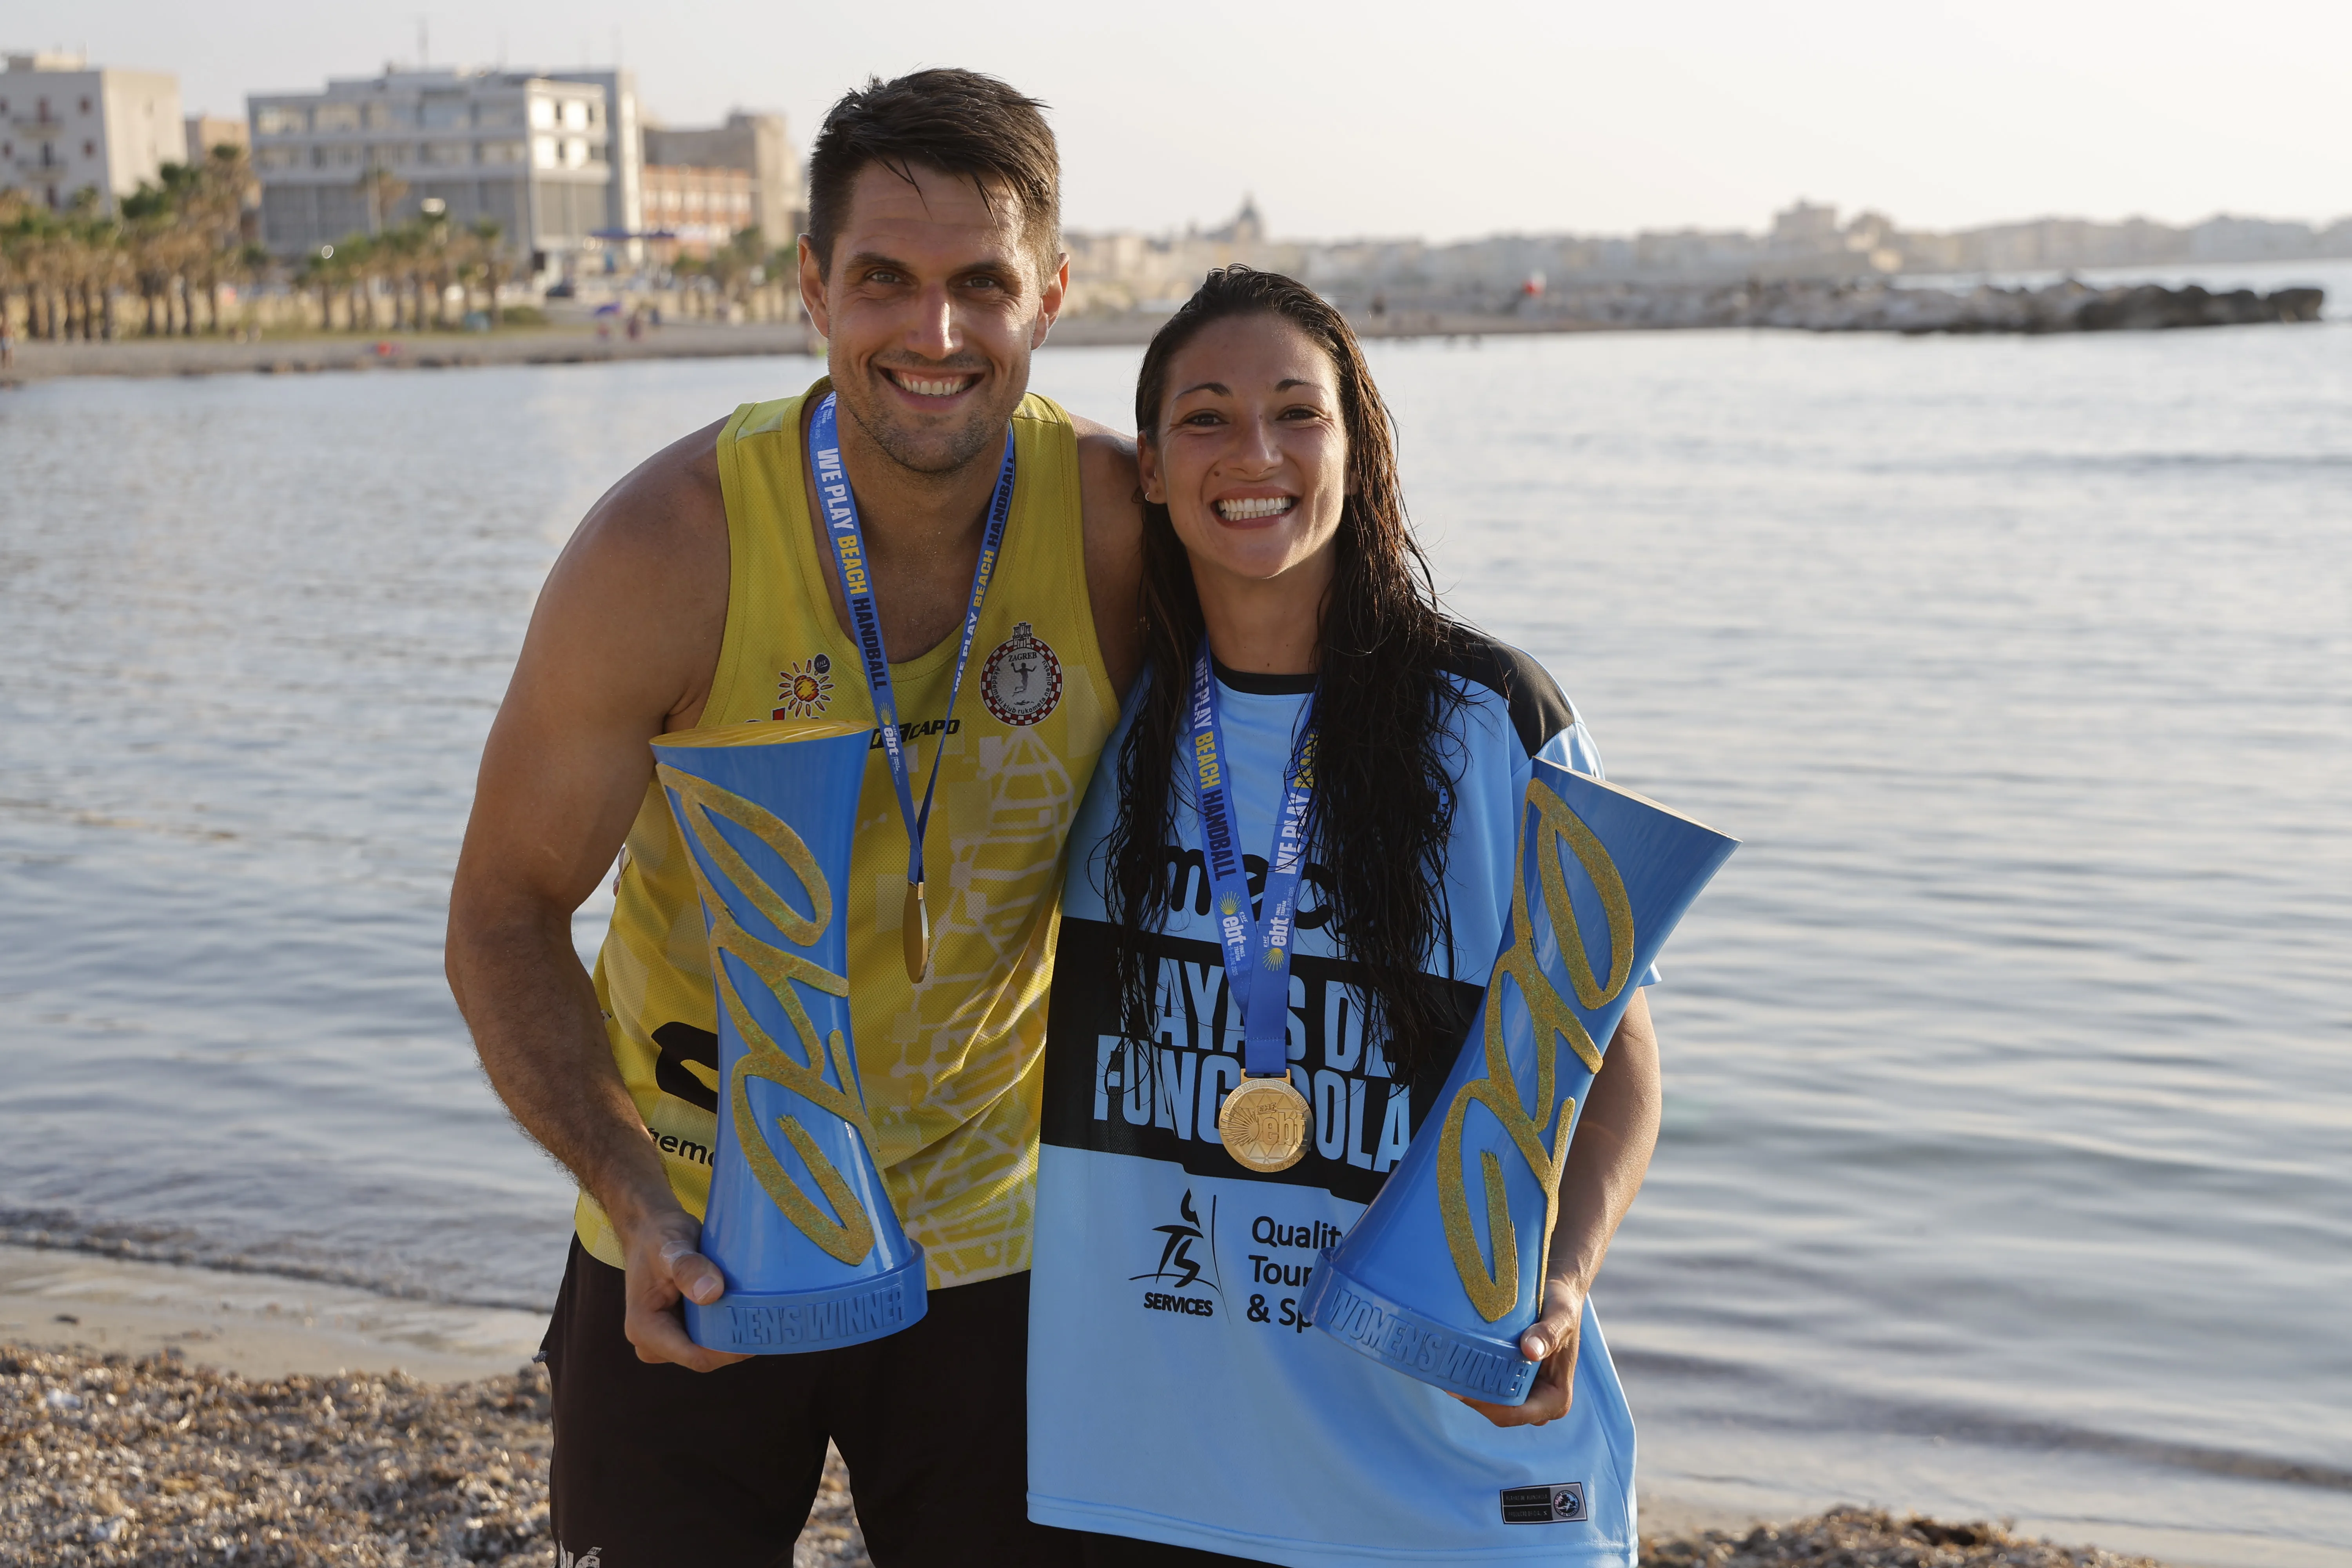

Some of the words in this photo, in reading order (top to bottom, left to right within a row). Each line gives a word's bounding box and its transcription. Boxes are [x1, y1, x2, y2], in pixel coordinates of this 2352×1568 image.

[817, 448, 842, 482] WE
[824, 484, 854, 529] PLAY
[837, 535, 868, 595] BEACH
[954, 661, 965, 692] WE
[962, 612, 978, 657] PLAY
[973, 550, 995, 607] BEACH
[987, 457, 1014, 547] HANDBALL
[852, 597, 887, 691] HANDBALL
[1008, 652, 1037, 662] ZAGREB
[1194, 655, 1208, 689] WE
[1003, 703, 1016, 713] klub
[1018, 697, 1046, 714] rukometa
[1044, 688, 1050, 697] na
[1194, 687, 1212, 730] PLAY
[883, 727, 899, 755] ebt
[1195, 731, 1221, 789] BEACH
[1202, 788, 1236, 881] HANDBALL
[1275, 842, 1302, 875] WE
[1222, 916, 1247, 946] ebt
[1240, 911, 1248, 923] EHF
[1269, 917, 1289, 946] ebt
[1323, 980, 1396, 1078] DE
[1223, 1087, 1244, 1111] EUROPEAN
[1241, 1080, 1258, 1093] BEACH
[1258, 1079, 1285, 1091] HANDBALL
[1285, 1085, 1298, 1098] TOUR
[1294, 1094, 1310, 1112] FINALS
[1257, 1102, 1276, 1113] EHF
[1263, 1111, 1307, 1148] ebt
[1252, 1216, 1343, 1249] Qualit
[726, 1305, 803, 1345] MEN'S
[806, 1283, 905, 1342] WINNER
[1143, 1292, 1213, 1317] SERVICES
[1247, 1294, 1270, 1323] &
[1329, 1285, 1442, 1372] WOMEN'S
[1437, 1340, 1530, 1398] WINNER
